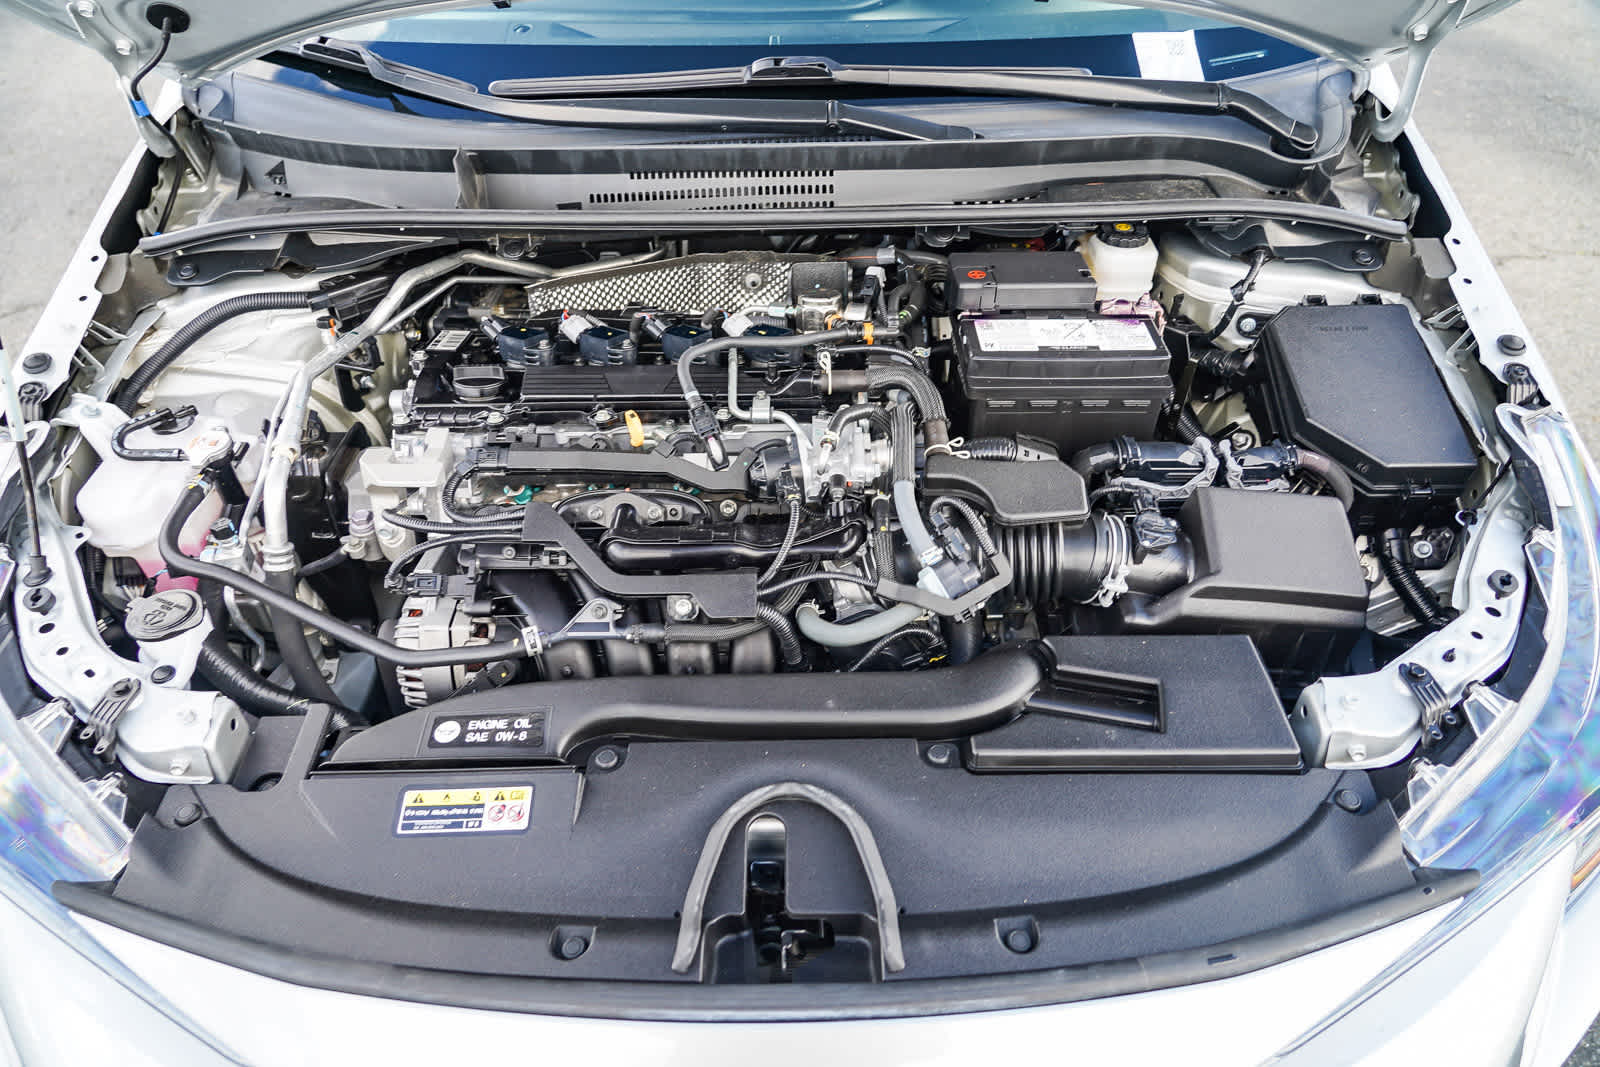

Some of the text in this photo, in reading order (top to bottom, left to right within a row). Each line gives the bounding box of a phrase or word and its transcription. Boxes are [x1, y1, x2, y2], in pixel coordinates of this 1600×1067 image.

[467, 718, 532, 730] ENGINE OIL
[465, 732, 489, 742] SAE
